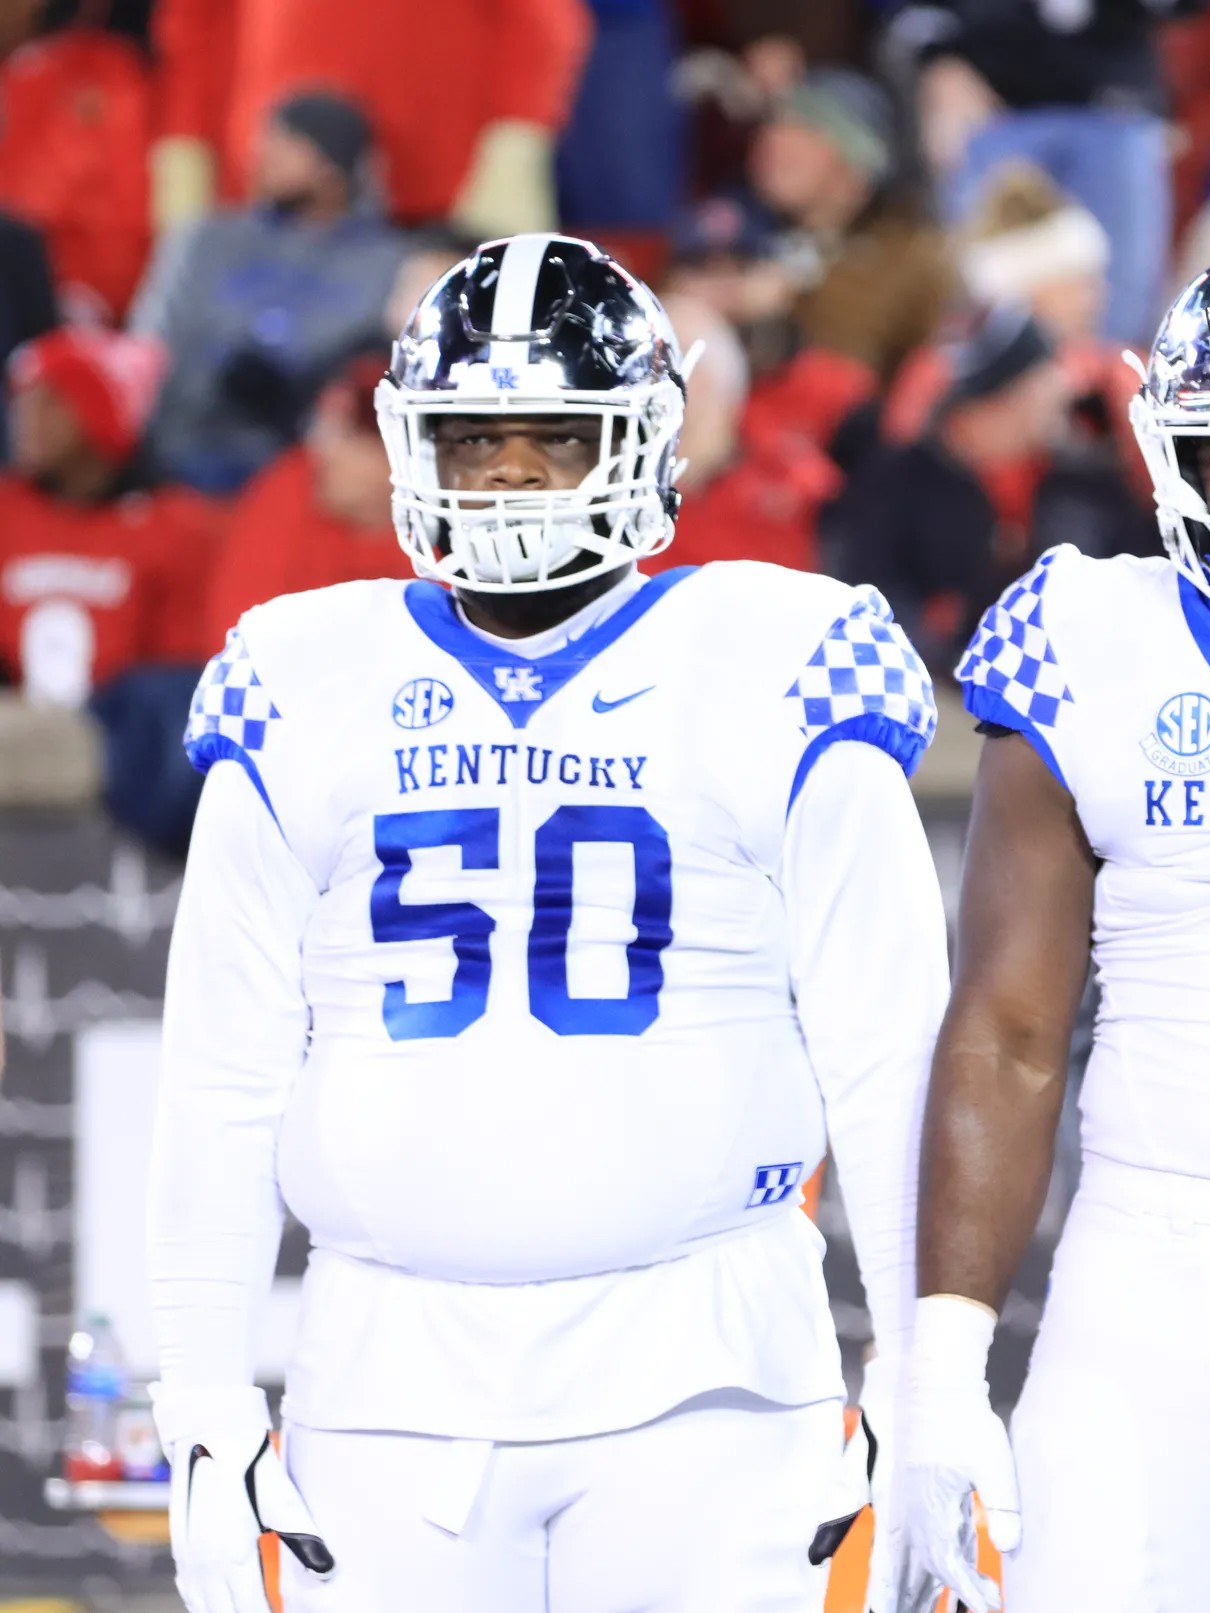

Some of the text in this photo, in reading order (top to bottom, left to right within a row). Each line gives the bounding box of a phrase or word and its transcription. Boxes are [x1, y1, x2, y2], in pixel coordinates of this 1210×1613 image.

[393, 678, 454, 729] SEC
[493, 666, 544, 702] UK
[394, 744, 648, 794] KENTUCKY
[370, 805, 674, 1042] 50
